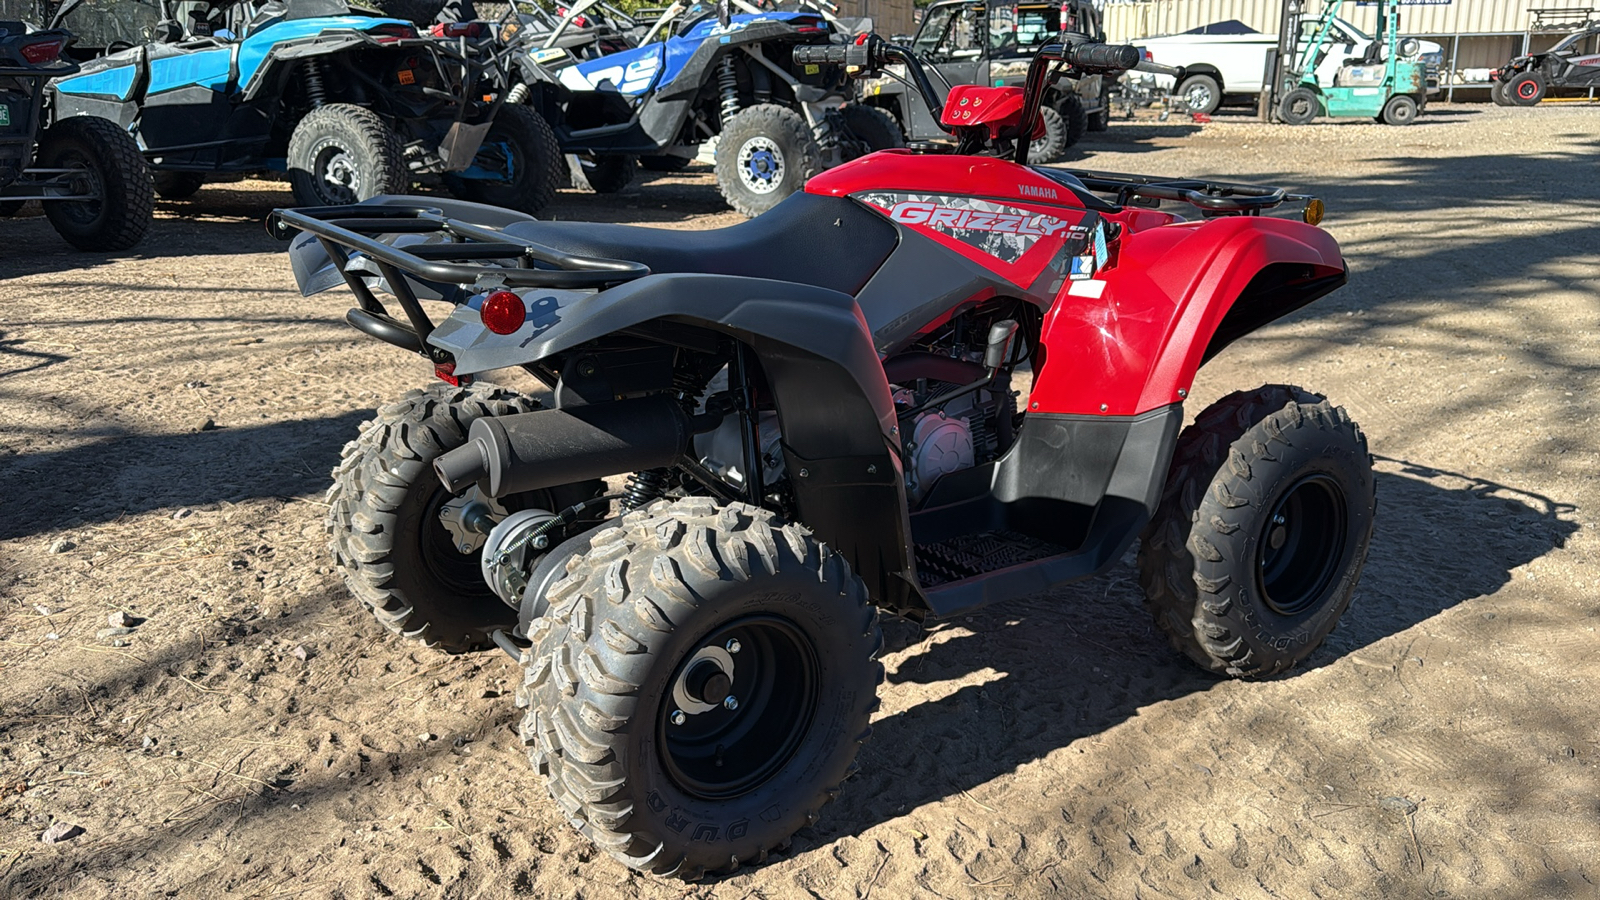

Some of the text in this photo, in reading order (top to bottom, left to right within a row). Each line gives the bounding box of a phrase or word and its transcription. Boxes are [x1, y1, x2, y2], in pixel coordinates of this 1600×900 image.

[1018, 183, 1058, 200] YAMAHA
[890, 202, 1068, 236] GRIZZLY
[1060, 231, 1086, 240] 110
[1069, 225, 1089, 233] EFI
[646, 788, 751, 843] DURO
